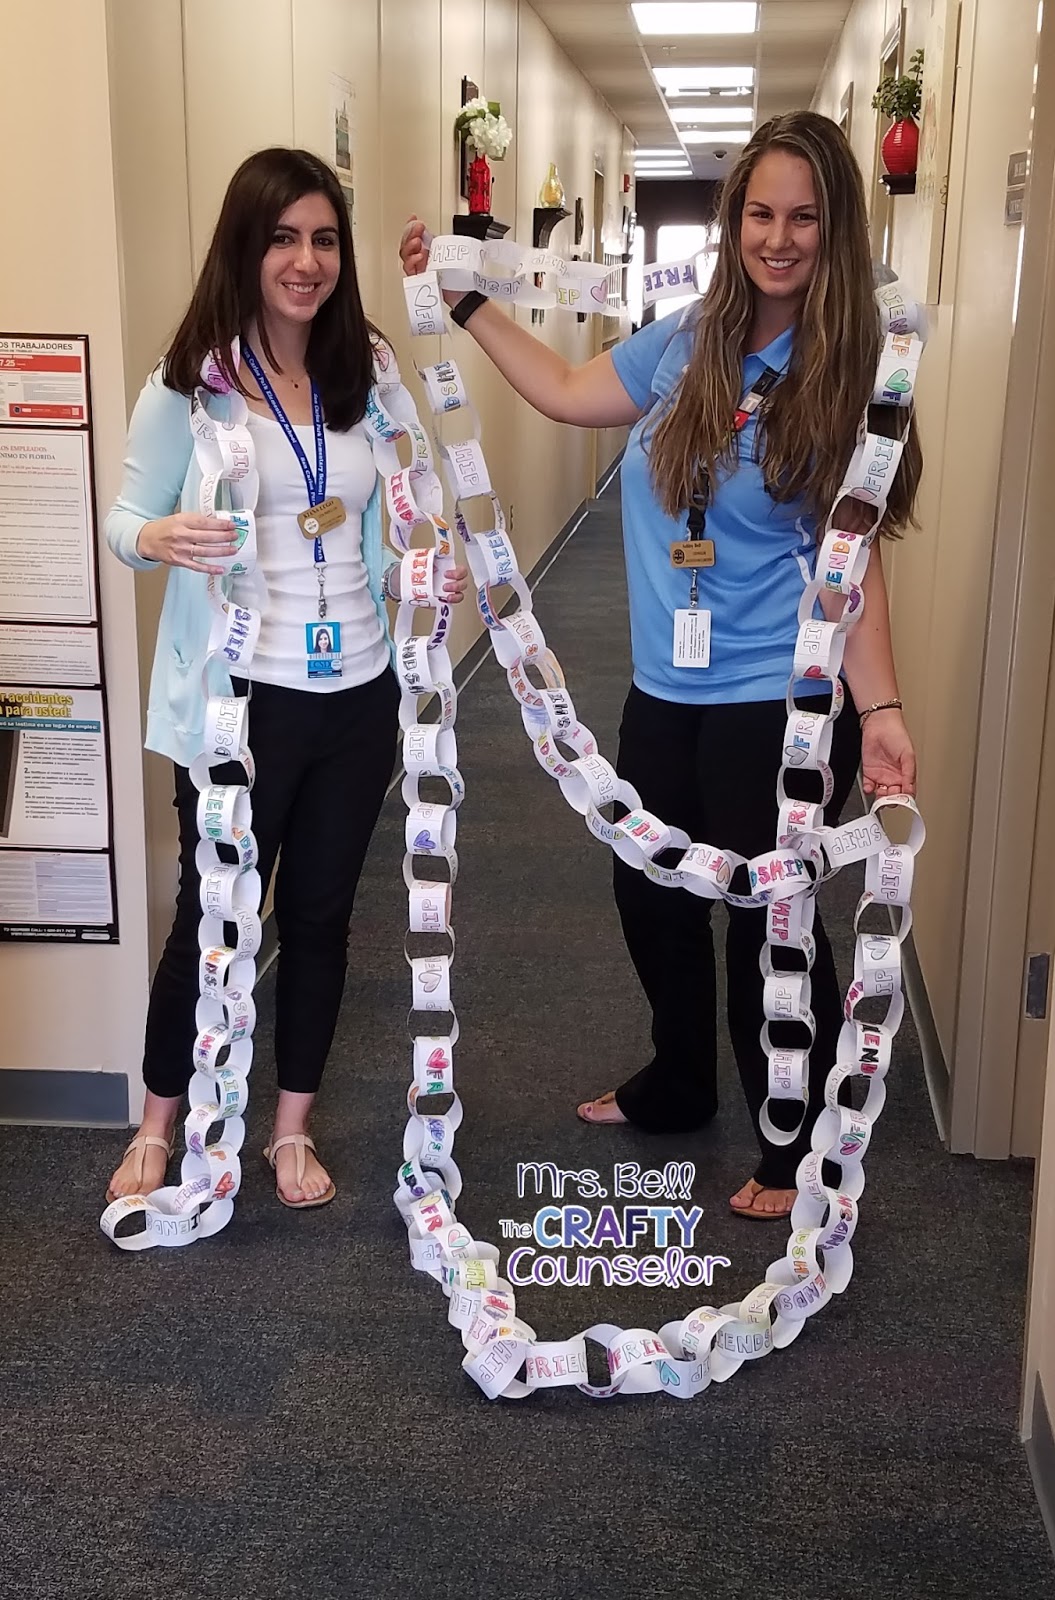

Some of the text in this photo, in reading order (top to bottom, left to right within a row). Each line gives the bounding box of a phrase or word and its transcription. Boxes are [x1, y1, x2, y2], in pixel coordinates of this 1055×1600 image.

[11, 342, 73, 350] TRABAJADORES
[249, 356, 261, 377] Carlos
[259, 376, 269, 391] Park
[266, 390, 286, 423] Elementary
[284, 420, 297, 443] School
[223, 609, 252, 661] SHIP
[5, 705, 32, 717] para
[35, 704, 72, 718] usted:
[8, 691, 74, 705] accidentes
[831, 822, 882, 856] SHIP
[881, 846, 903, 900] SHIP
